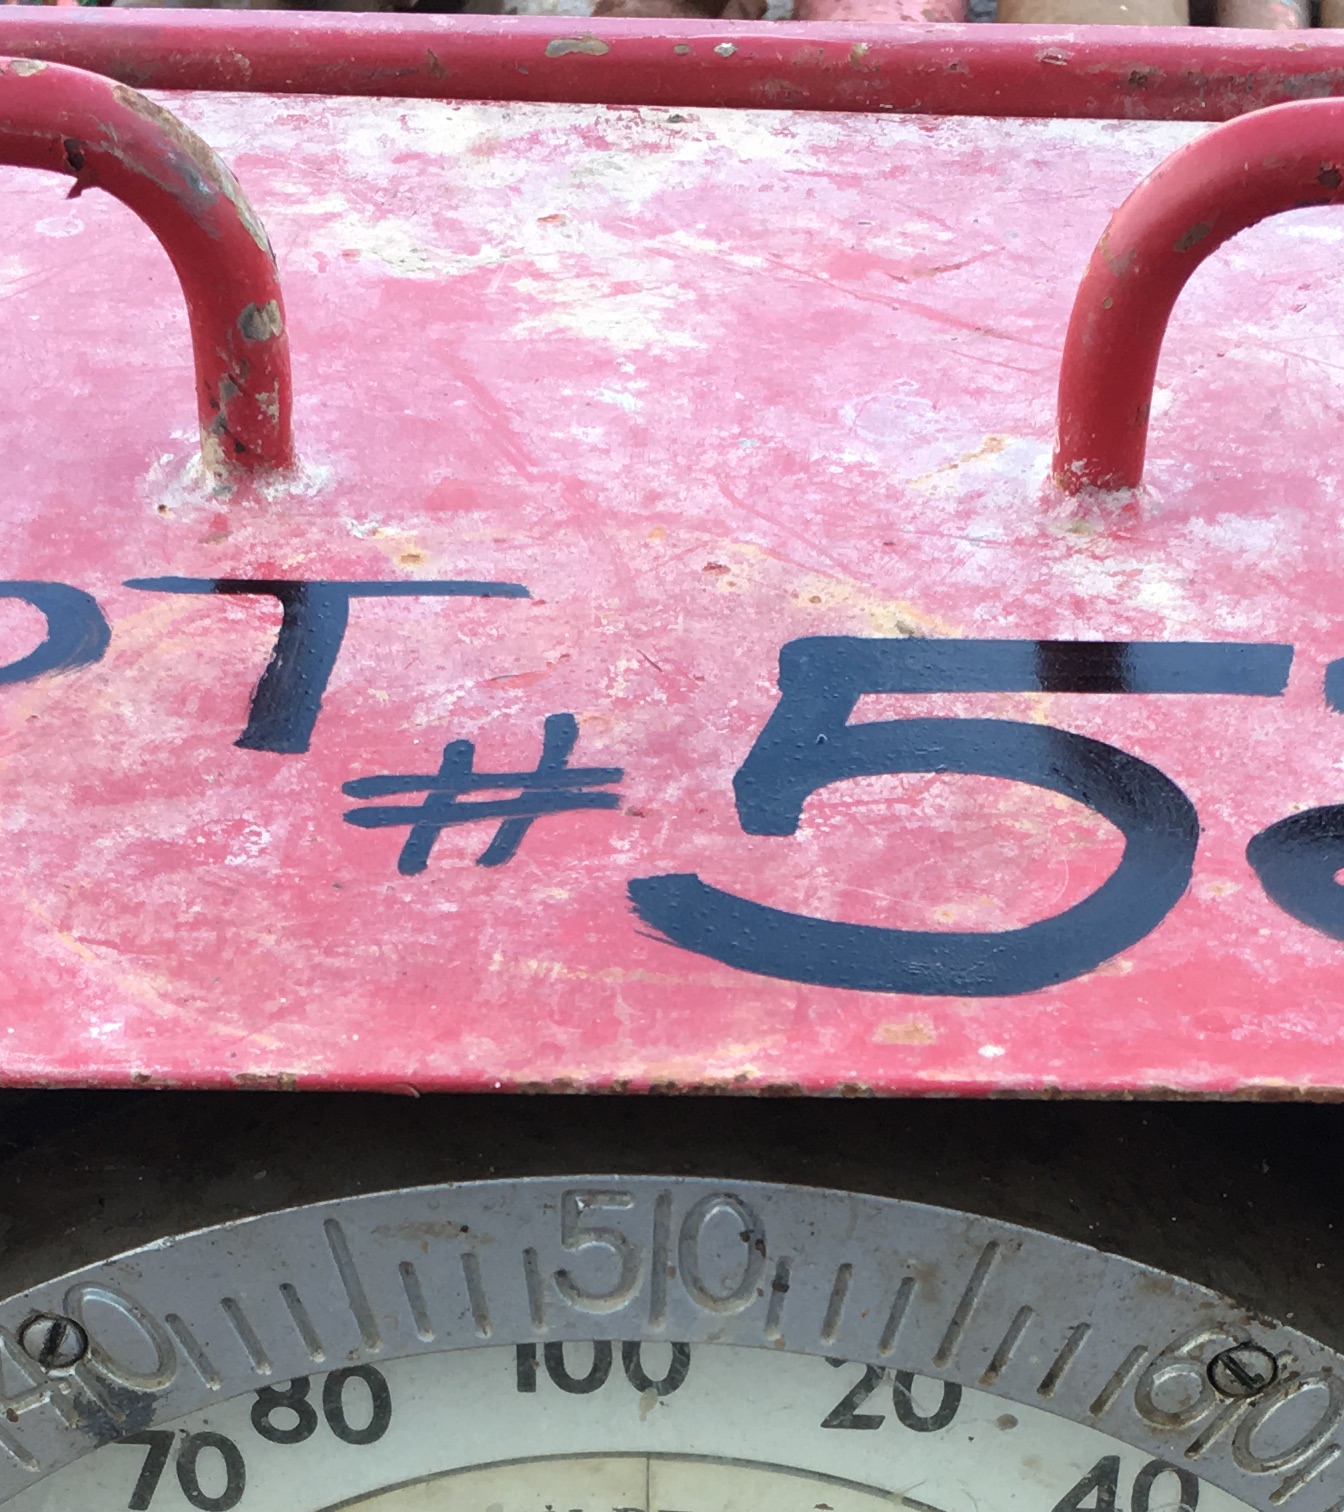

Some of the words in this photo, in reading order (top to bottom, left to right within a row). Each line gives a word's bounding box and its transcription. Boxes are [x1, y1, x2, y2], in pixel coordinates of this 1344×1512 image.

[250, 1363, 393, 1446] 80
[515, 1339, 692, 1397] 100
[820, 1355, 964, 1433] 20
